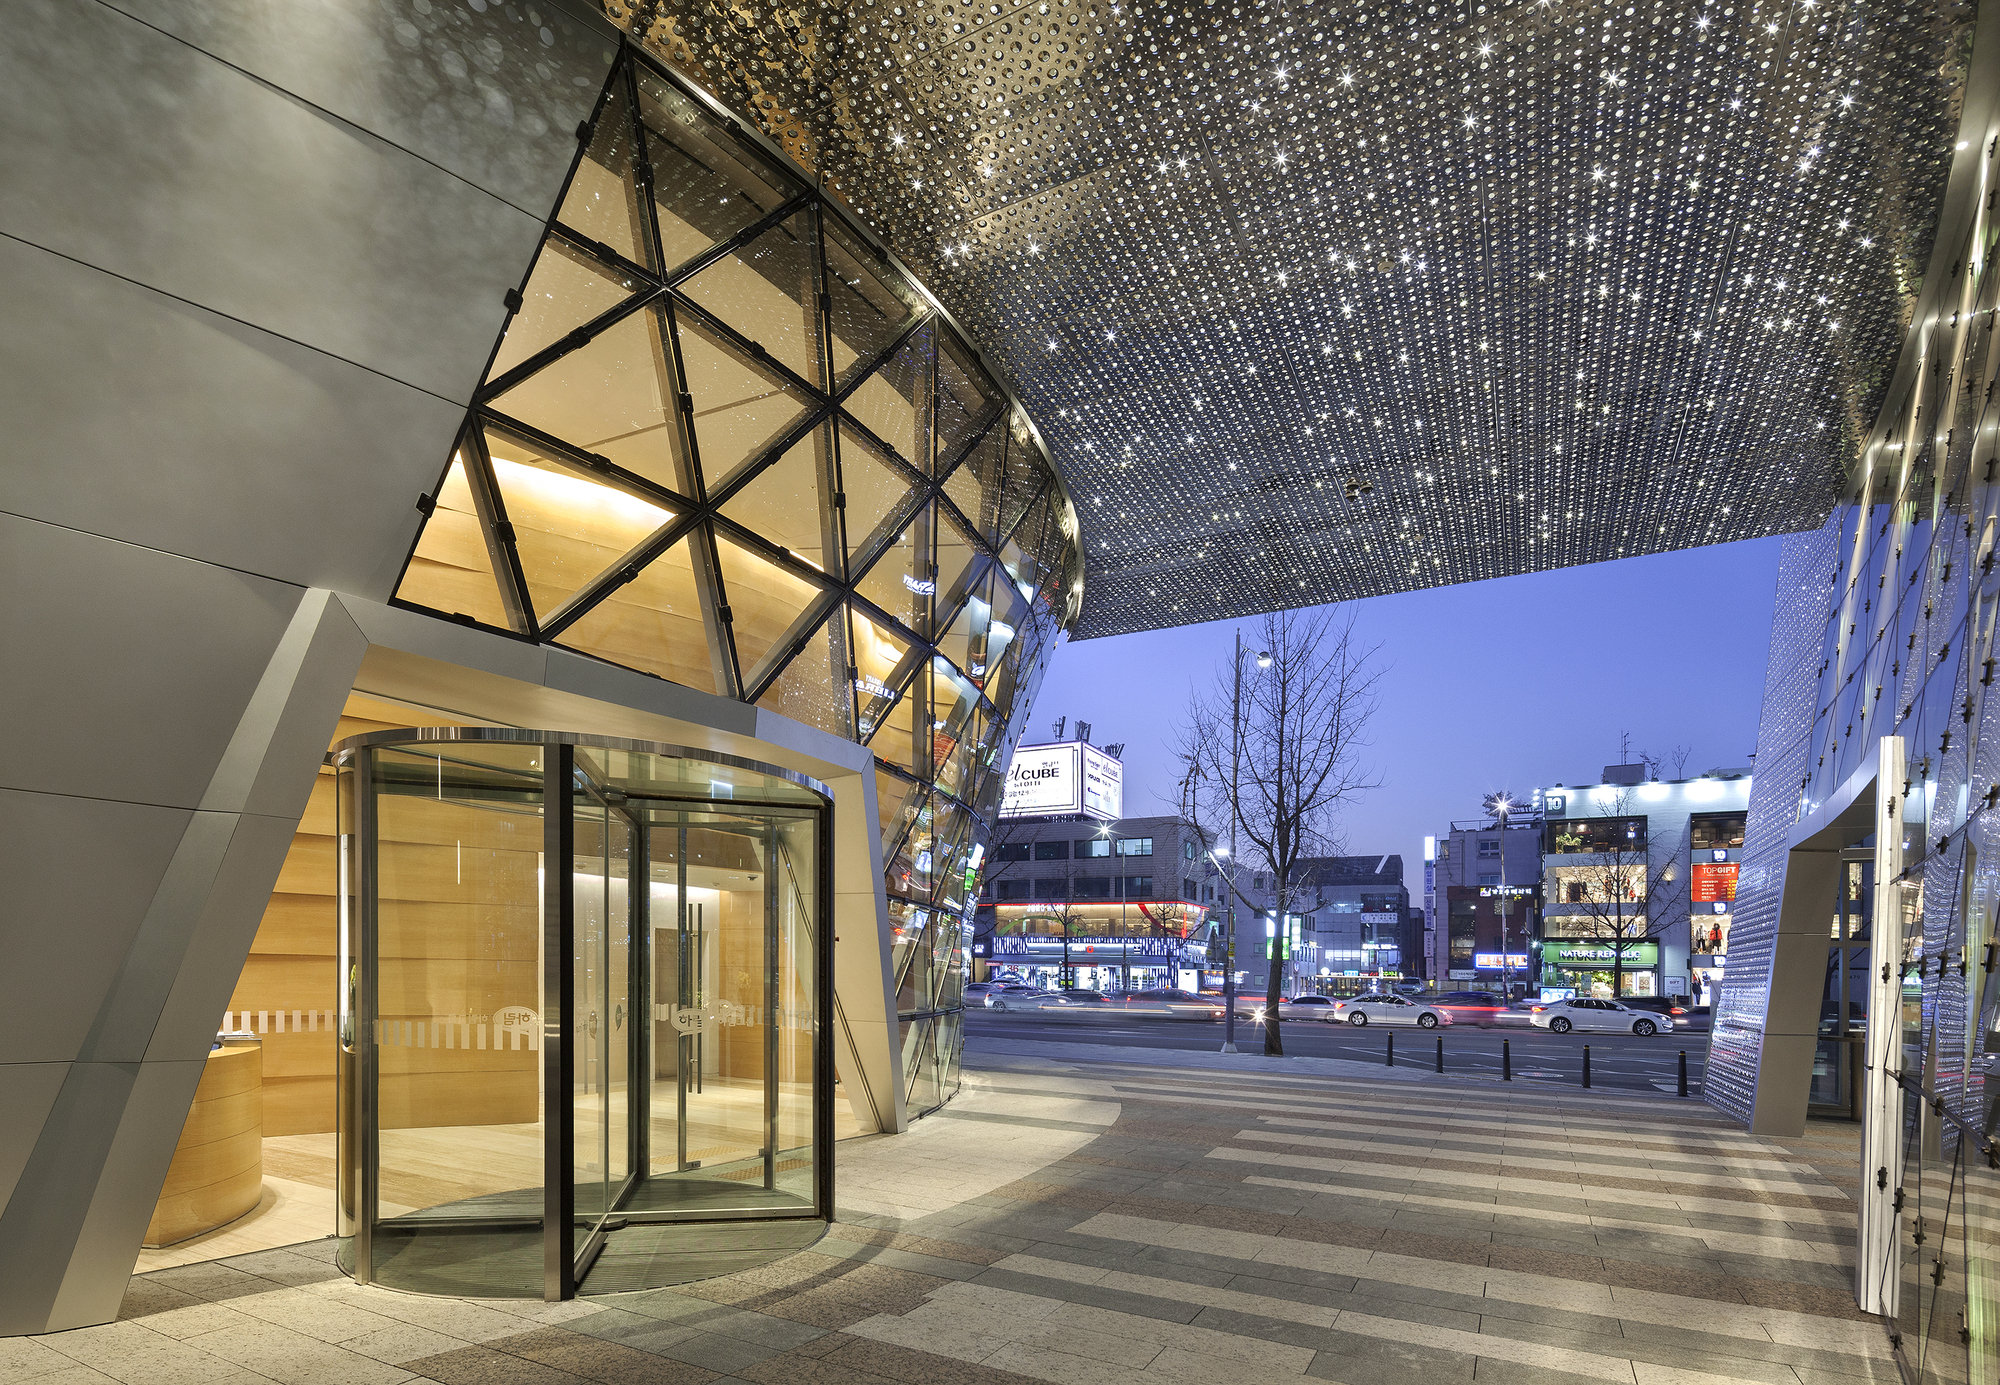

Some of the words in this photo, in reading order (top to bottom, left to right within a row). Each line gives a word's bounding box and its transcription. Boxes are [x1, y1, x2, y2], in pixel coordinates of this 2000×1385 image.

[1546, 797, 1562, 811] 10
[1713, 850, 1727, 860] 10
[1713, 902, 1727, 912] 10
[1559, 950, 1596, 958] NATURE
[1713, 955, 1727, 965] 10
